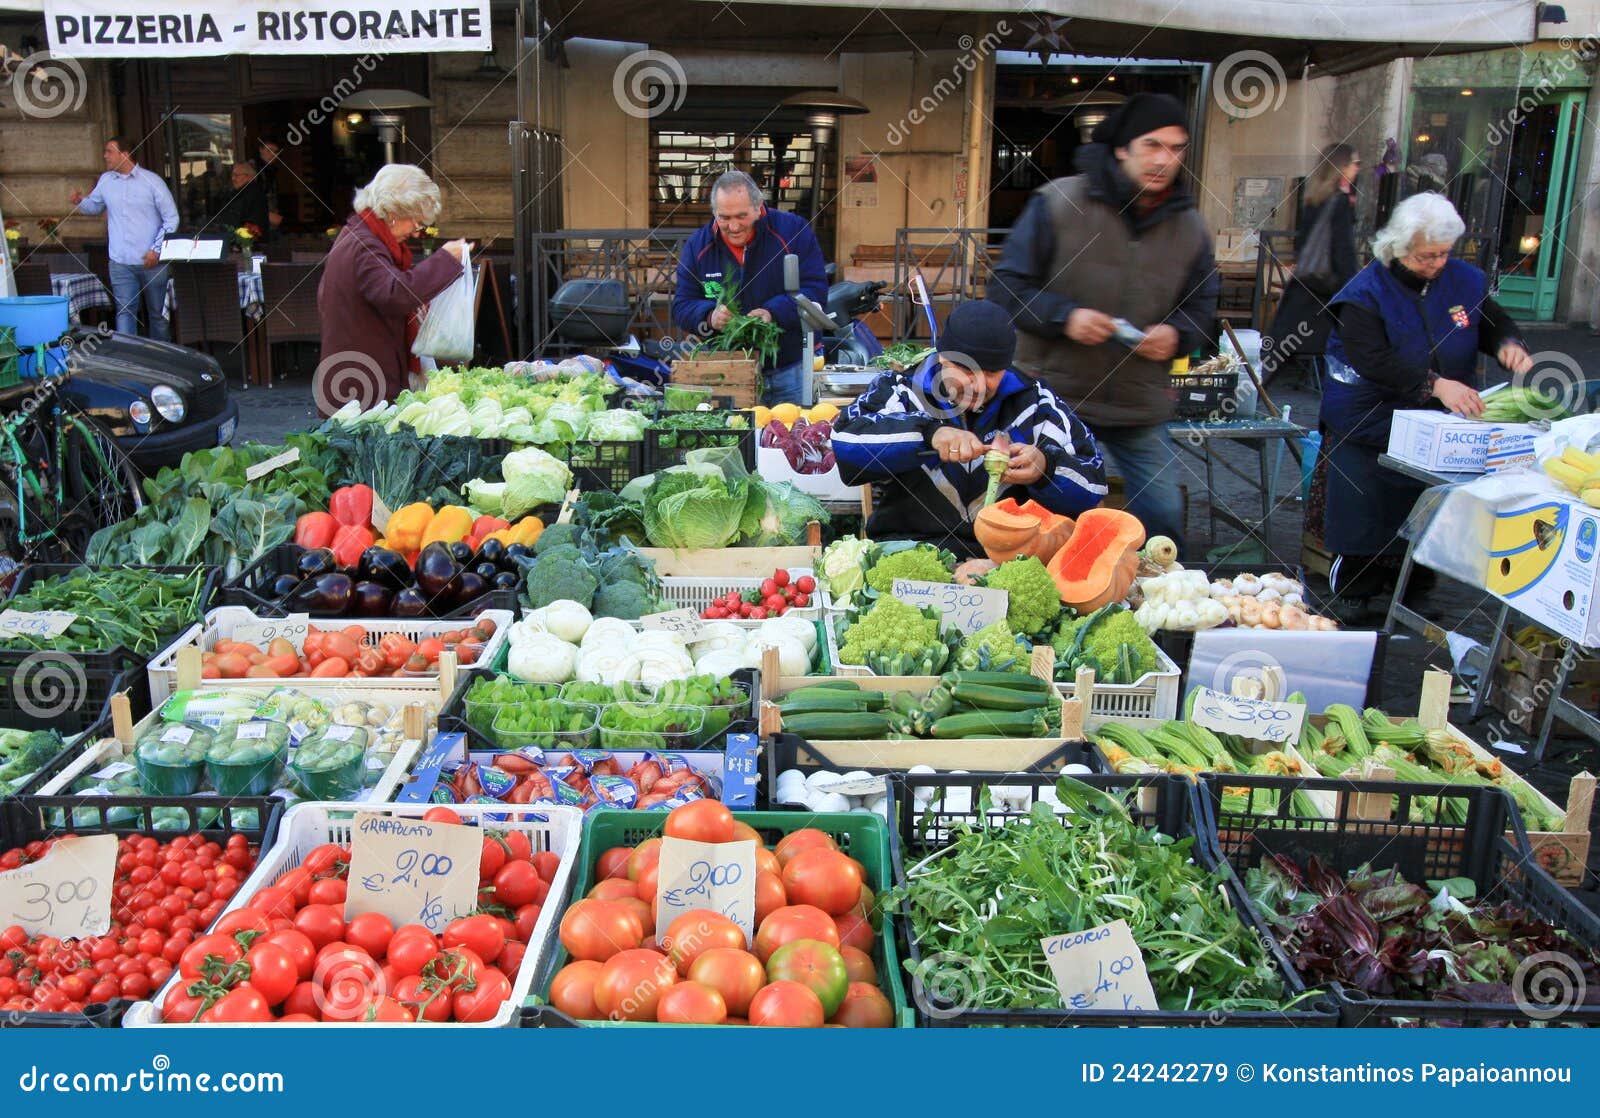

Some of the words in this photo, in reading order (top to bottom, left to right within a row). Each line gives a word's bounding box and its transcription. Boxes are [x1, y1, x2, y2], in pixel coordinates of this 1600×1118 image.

[55, 13, 223, 45] PIZZERIA
[257, 7, 482, 41] RISTORANTE
[1443, 432, 1490, 445] SACCHE
[1228, 704, 1293, 725] 3,00
[360, 818, 433, 836] GRAPPOLATO
[392, 849, 453, 888] 2,00
[685, 861, 742, 900] 2,00
[13, 876, 98, 927] 3,00
